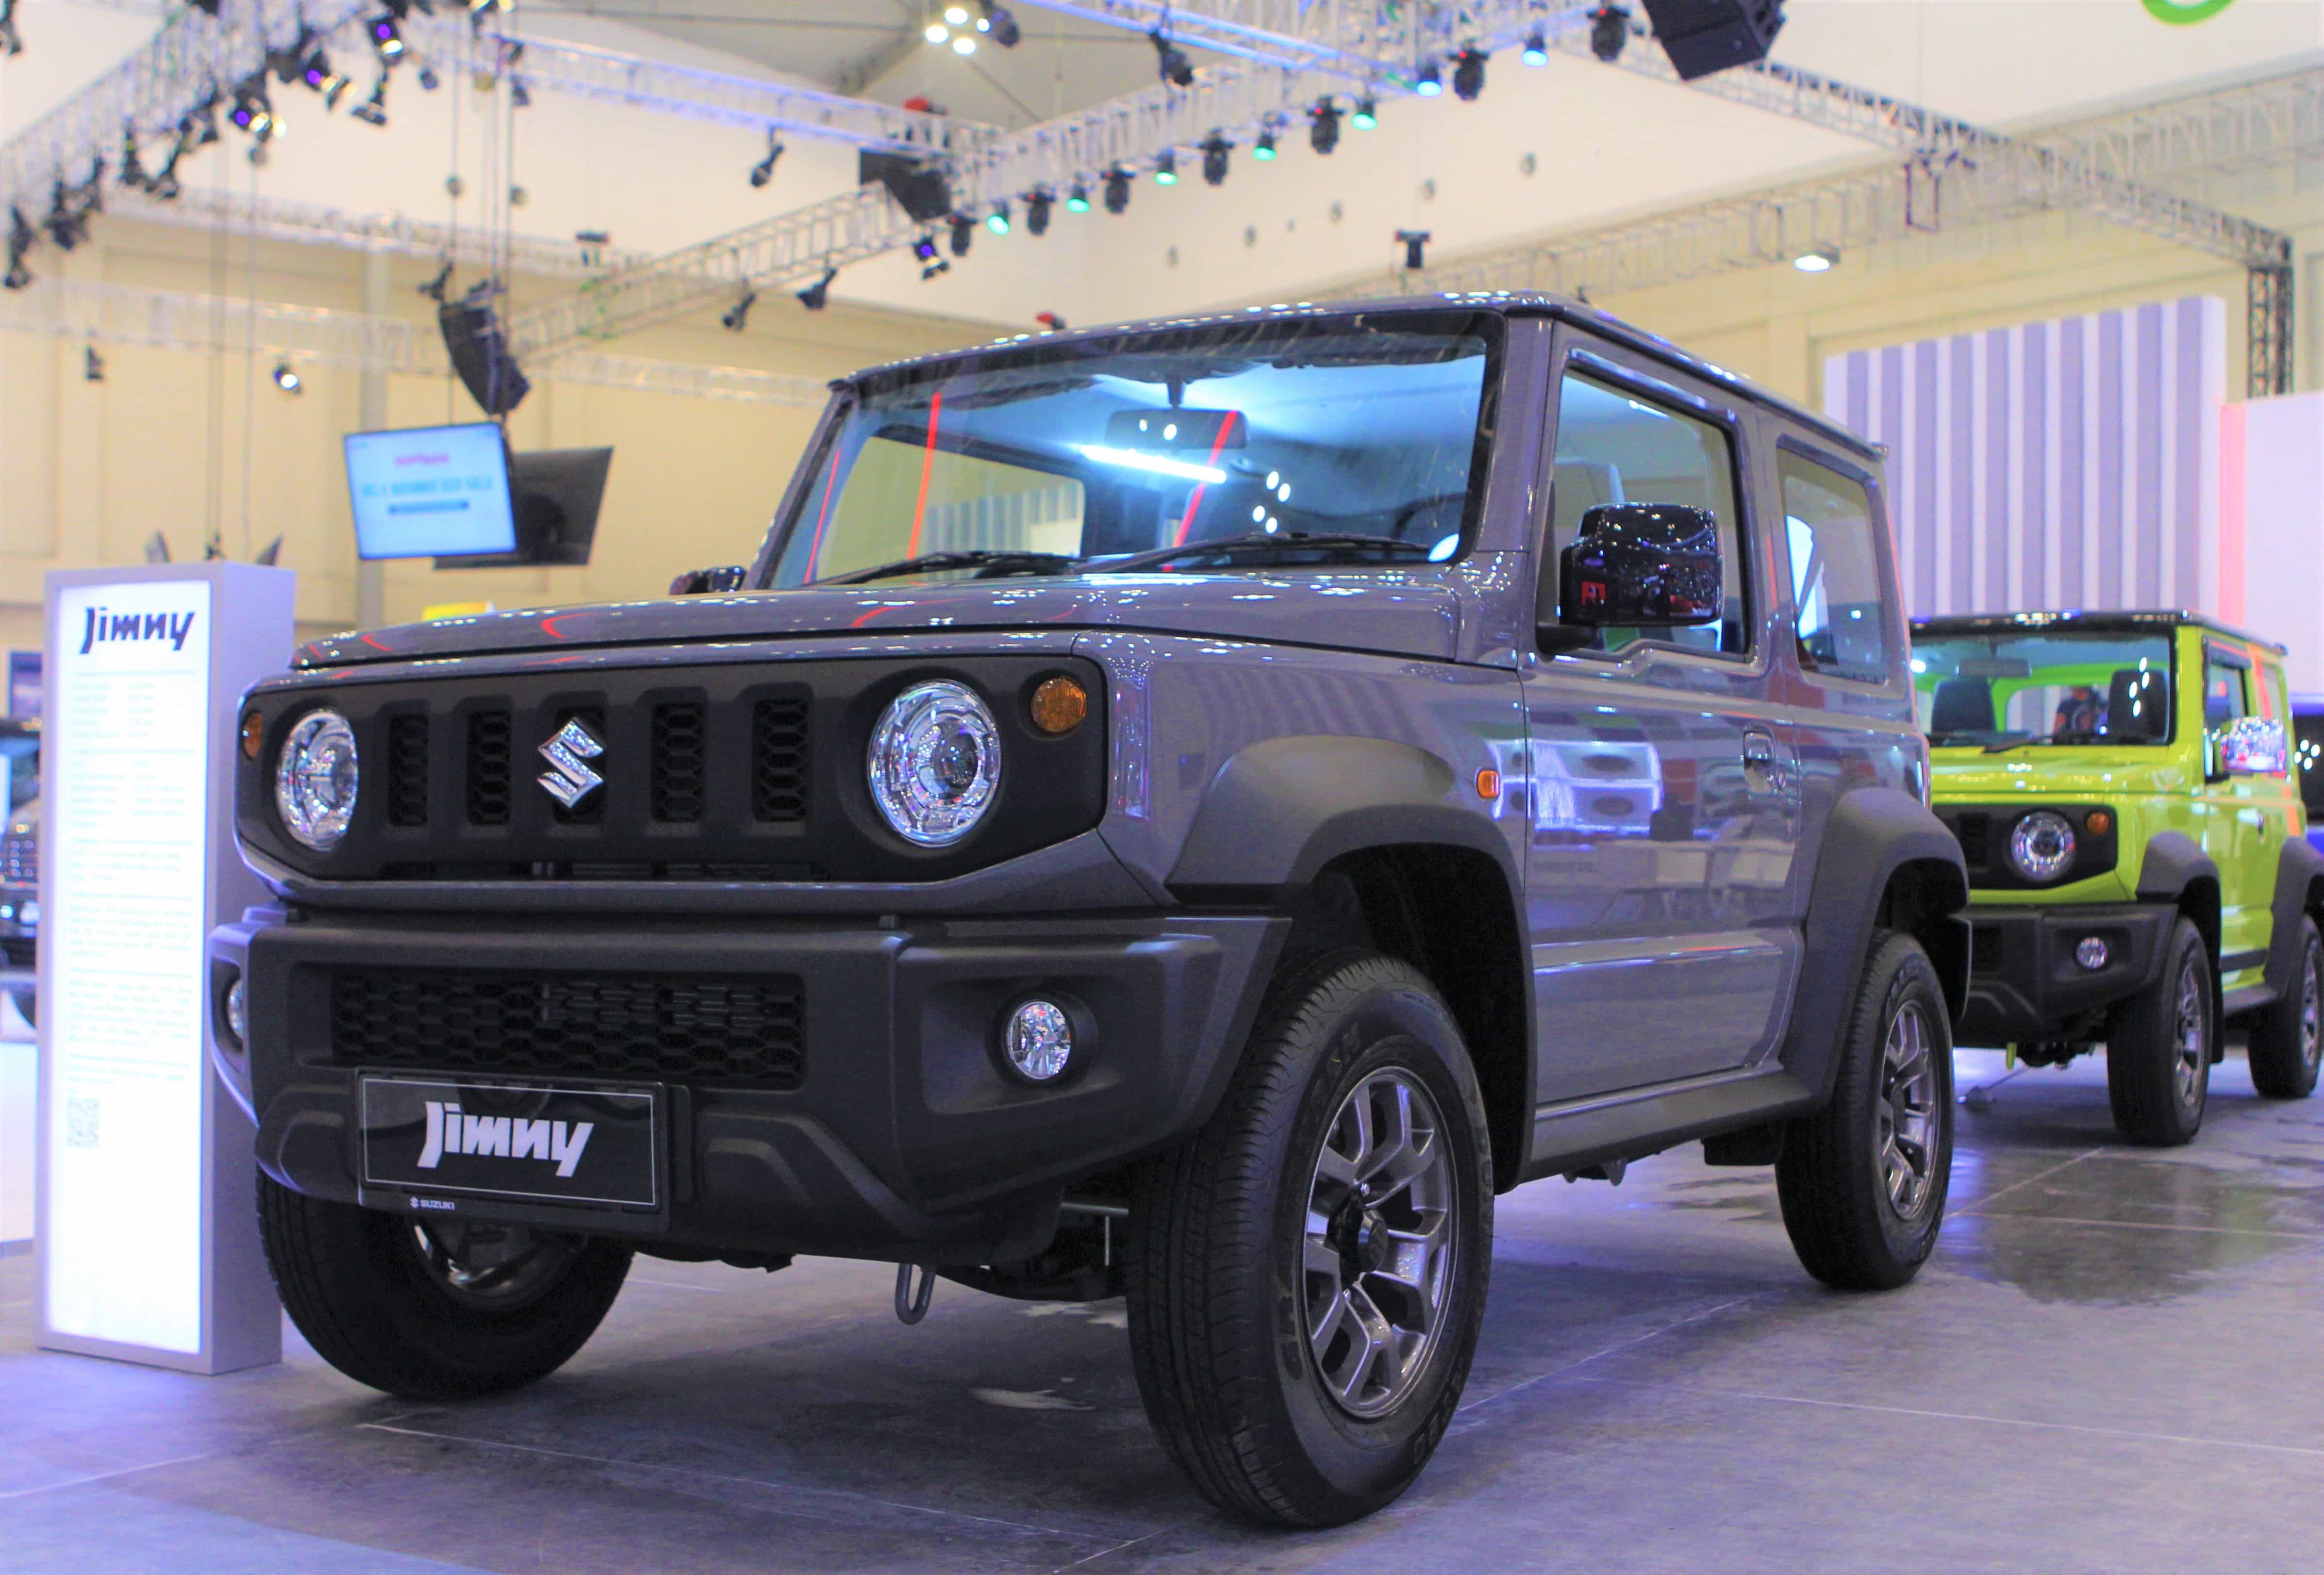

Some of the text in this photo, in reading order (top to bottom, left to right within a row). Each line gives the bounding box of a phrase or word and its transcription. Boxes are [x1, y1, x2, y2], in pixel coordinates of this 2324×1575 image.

[79, 606, 195, 654] Jimny
[417, 1101, 594, 1177] Jimny
[420, 1199, 455, 1210] SUZUKI
